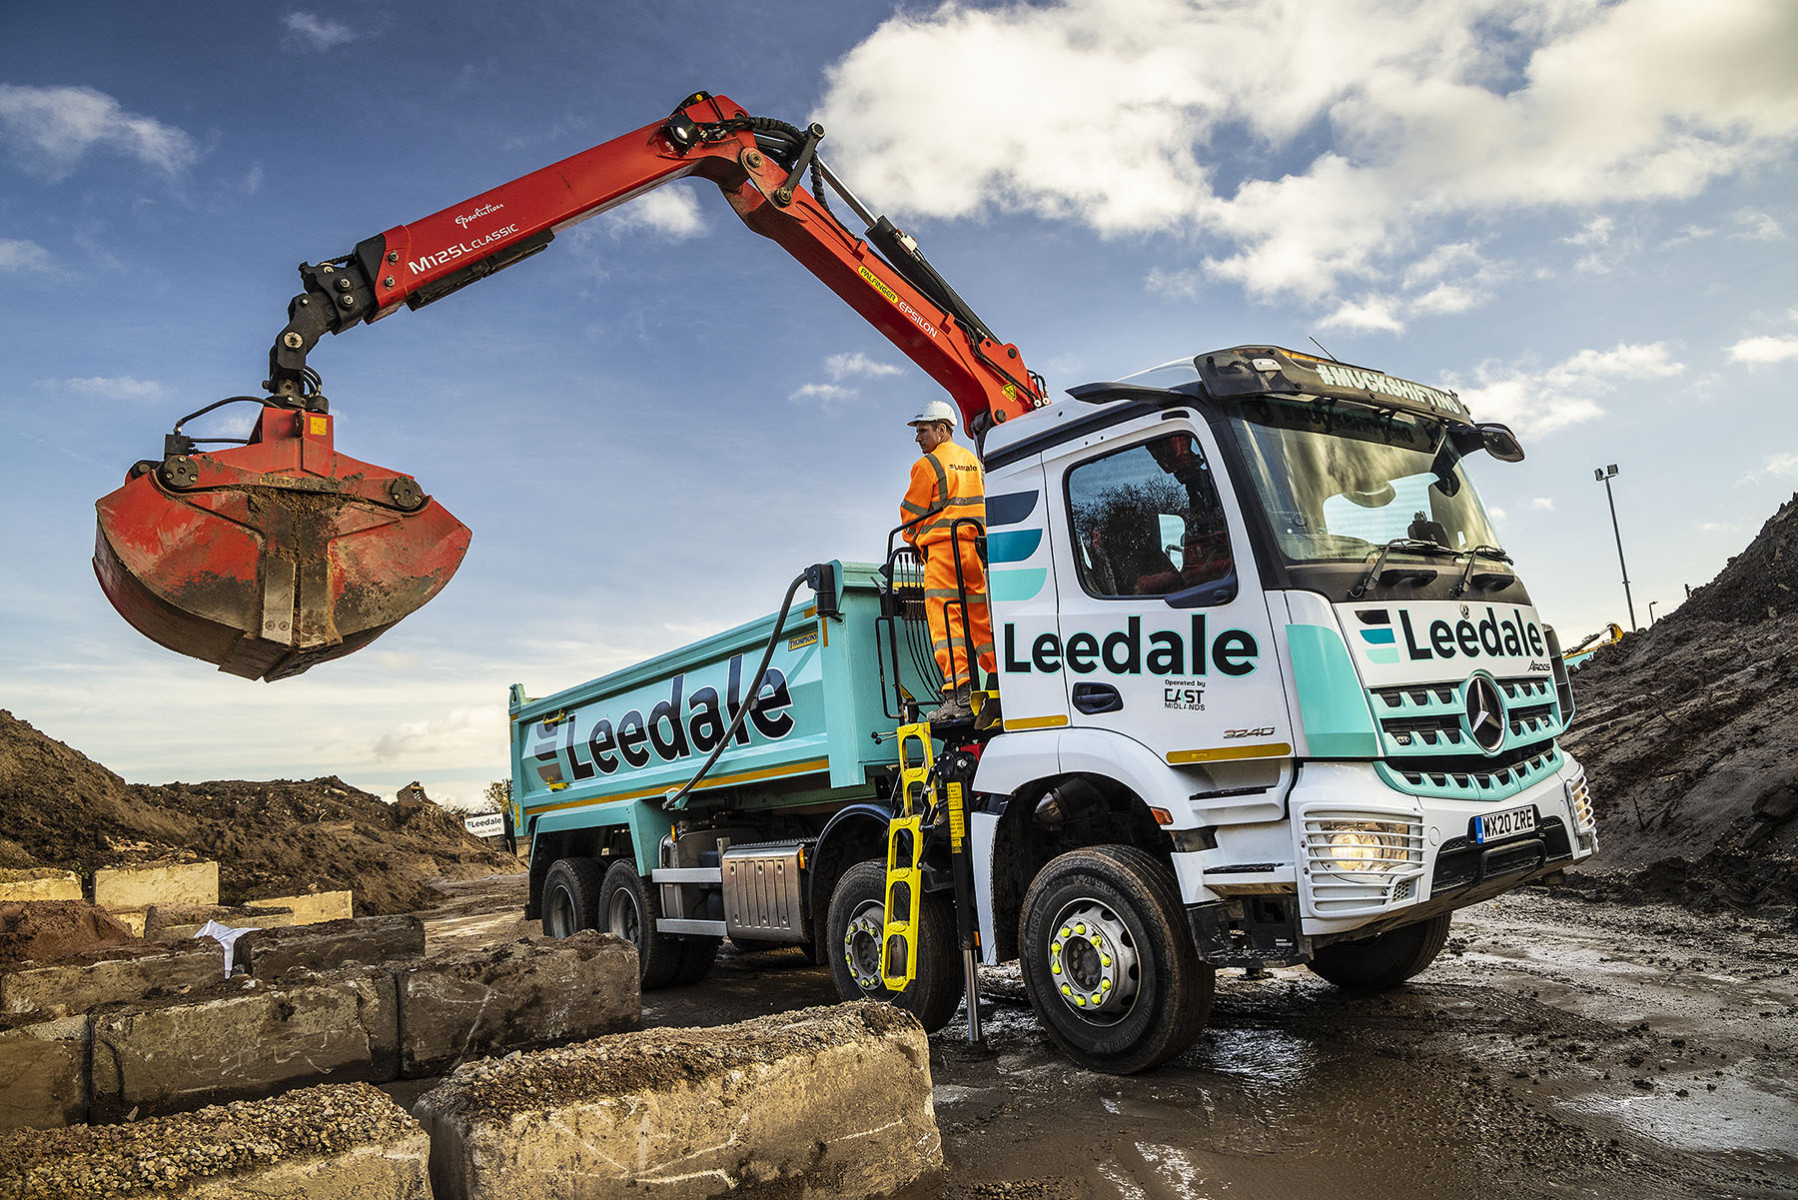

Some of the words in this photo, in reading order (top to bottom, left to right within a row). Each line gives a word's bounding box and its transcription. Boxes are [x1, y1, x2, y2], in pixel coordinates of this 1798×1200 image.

[455, 203, 504, 229] Epsolution
[408, 243, 473, 275] M125L
[471, 223, 519, 249] CLASSIC
[860, 267, 897, 303] PALFINGER
[898, 301, 938, 338] EPSILON
[1315, 364, 1461, 415] #MUCKSHIFTING
[1004, 612, 1260, 676] Leedale
[1398, 607, 1544, 661] Leedale
[1165, 688, 1205, 703] EAST
[1165, 703, 1206, 711] MIDLANDS
[565, 653, 795, 782] Leedale
[1223, 727, 1275, 739] 3240
[471, 817, 501, 827] Leedale
[1484, 814, 1511, 837] WX20
[1513, 809, 1533, 831] ZRE
